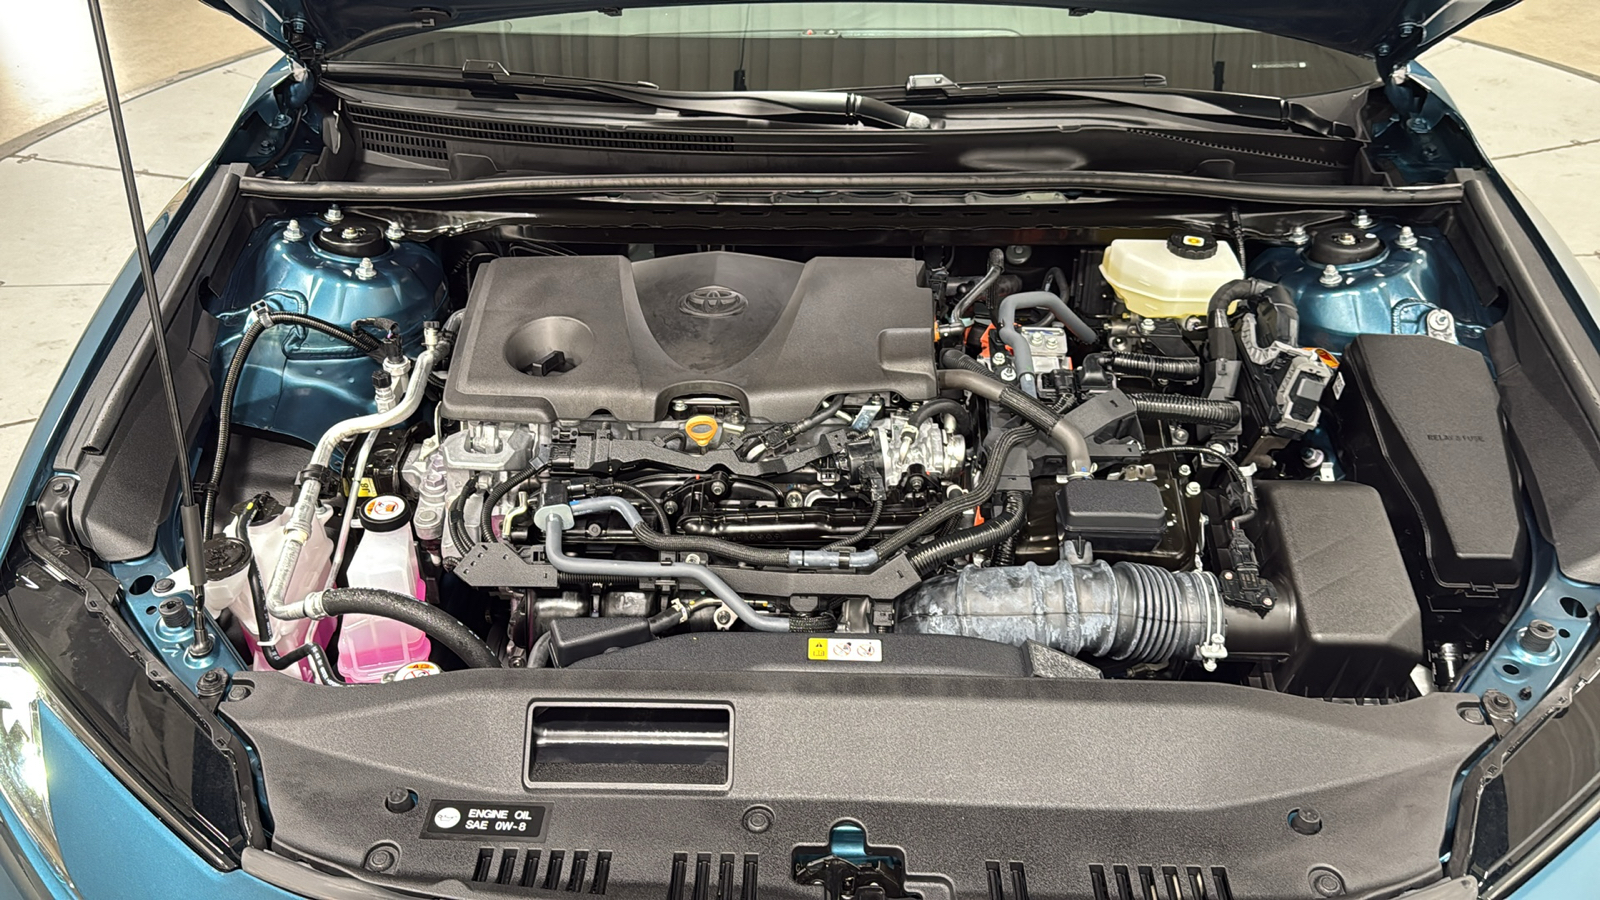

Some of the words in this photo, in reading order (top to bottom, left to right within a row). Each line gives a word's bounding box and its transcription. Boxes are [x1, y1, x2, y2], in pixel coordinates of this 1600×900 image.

[468, 808, 509, 819] ENGINE
[514, 810, 532, 820] OIL
[465, 819, 489, 830] SAE
[495, 821, 527, 831] 0W-8
